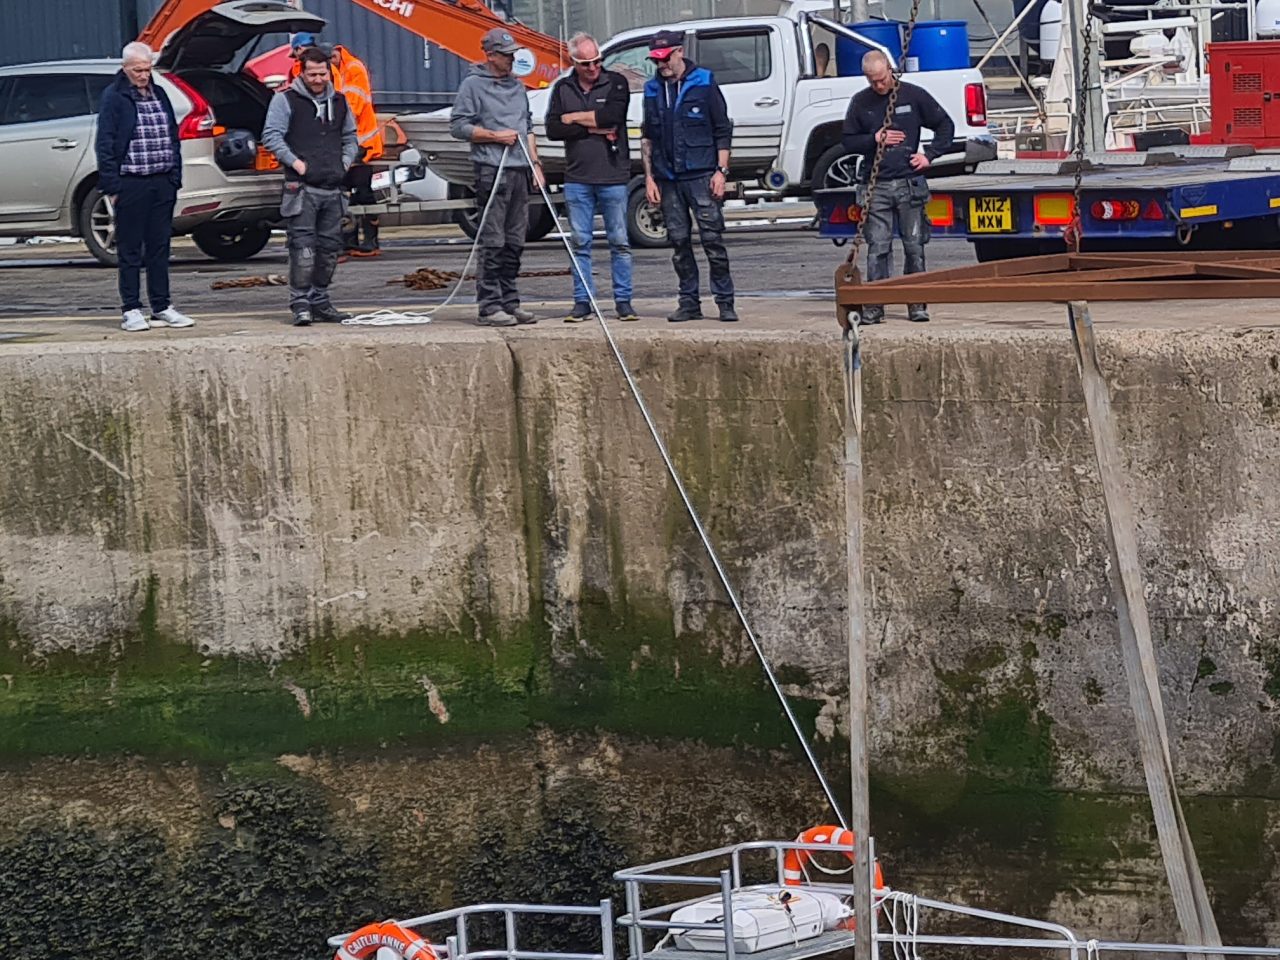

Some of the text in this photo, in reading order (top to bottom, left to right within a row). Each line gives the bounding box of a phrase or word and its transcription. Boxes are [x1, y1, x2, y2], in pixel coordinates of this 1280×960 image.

[975, 198, 1004, 213] MX12
[977, 214, 1003, 229] MXW
[347, 933, 406, 955] CAITLIN ANNE
